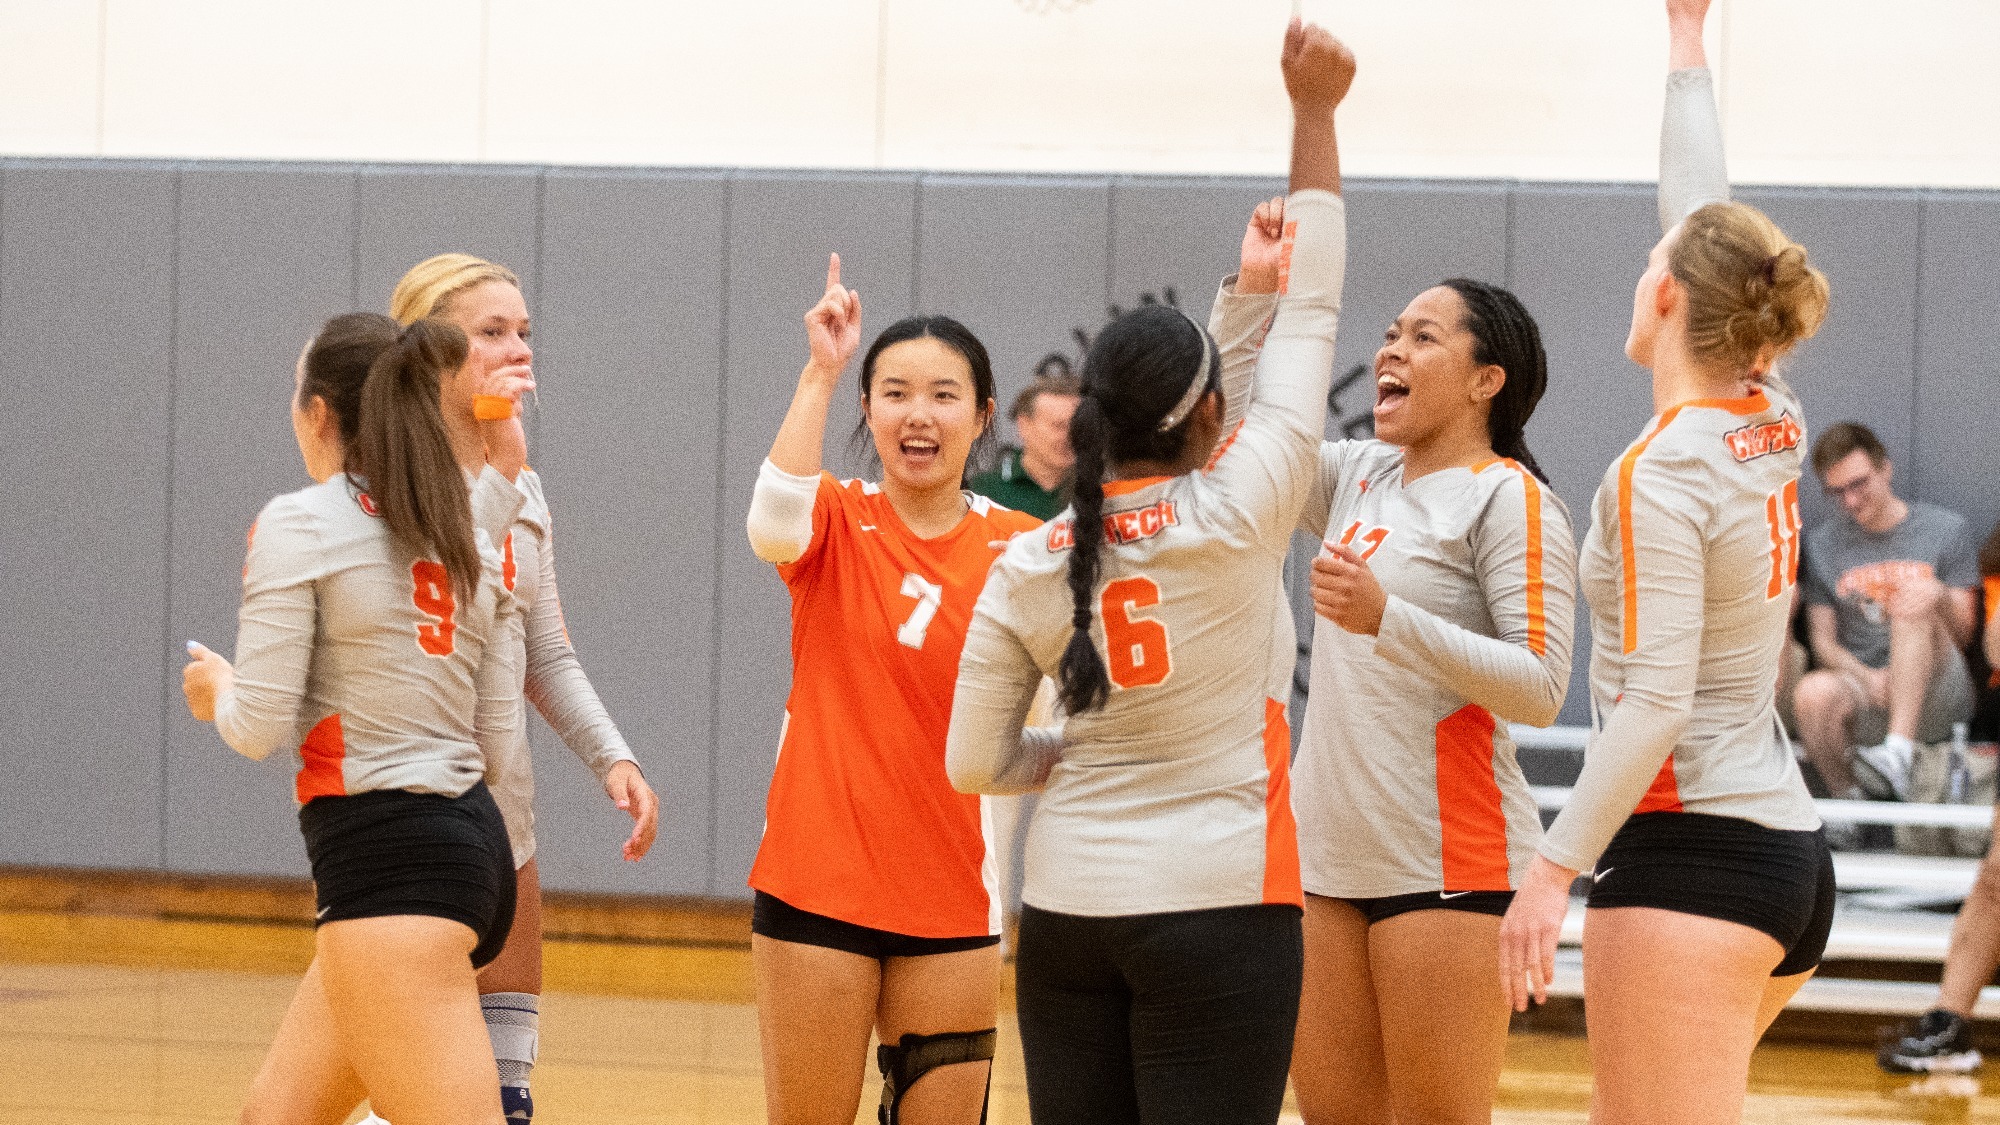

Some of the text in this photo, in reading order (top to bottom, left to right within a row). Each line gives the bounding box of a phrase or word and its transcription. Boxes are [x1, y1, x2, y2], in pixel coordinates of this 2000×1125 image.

[1046, 499, 1180, 552] CTECH
[409, 557, 458, 660] 9
[897, 571, 943, 650] 7
[1098, 575, 1174, 690] 6
